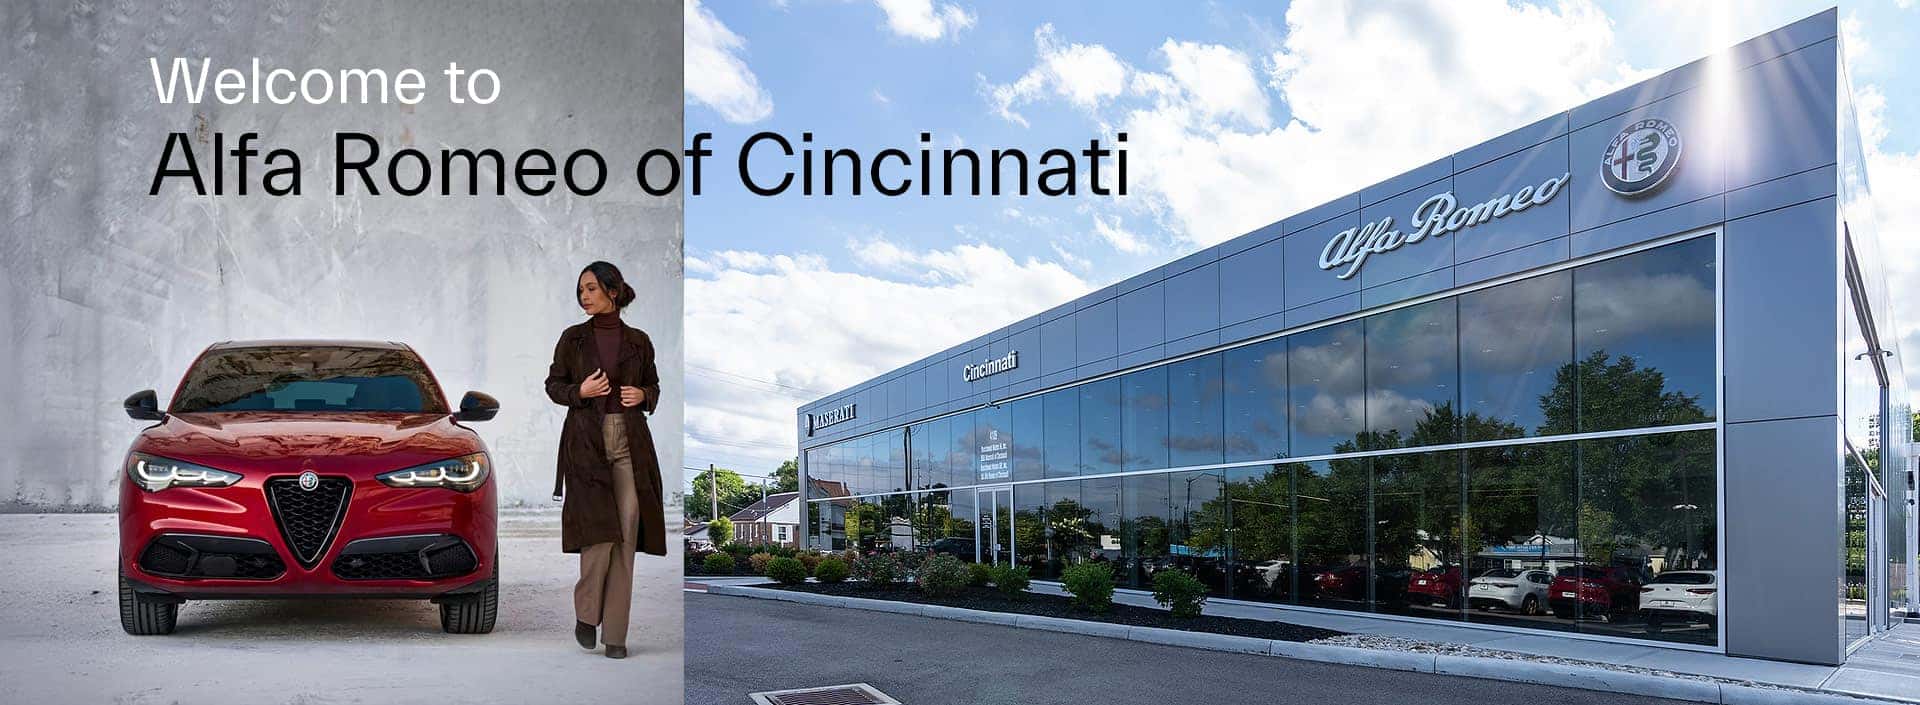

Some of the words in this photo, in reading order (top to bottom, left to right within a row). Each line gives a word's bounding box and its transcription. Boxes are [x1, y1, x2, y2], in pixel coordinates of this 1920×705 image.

[1603, 131, 1630, 167] ALFA
[1634, 119, 1678, 148] ROMEO
[1318, 216, 1407, 280] Alfa
[1404, 171, 1572, 244] Romeo
[962, 350, 1018, 382] Cincinnati
[813, 403, 856, 430] MASERATI
